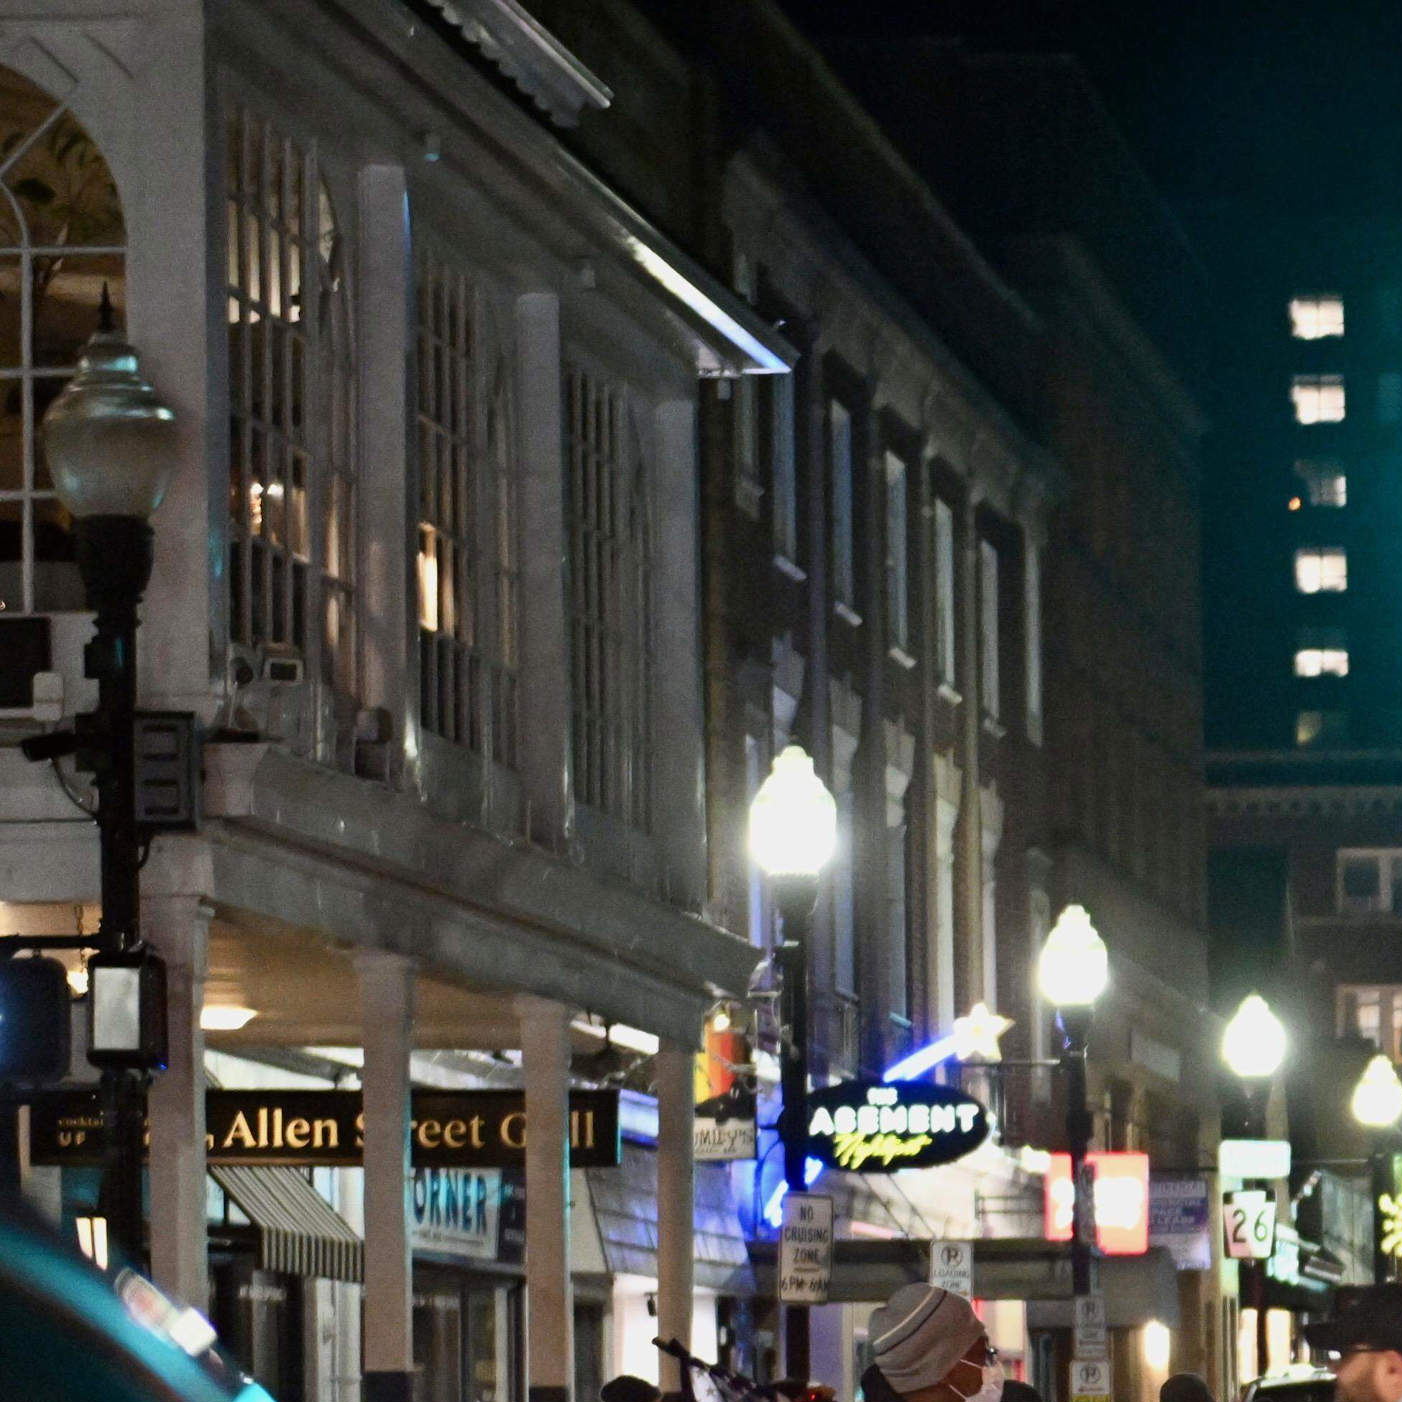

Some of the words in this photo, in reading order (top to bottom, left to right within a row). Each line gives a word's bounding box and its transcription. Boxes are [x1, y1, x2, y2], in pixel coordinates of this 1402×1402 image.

[223, 1107, 338, 1148] Allen
[500, 1109, 594, 1149] Gll
[412, 1167, 487, 1234] ORNER
[800, 1205, 814, 1221] NO
[1232, 1209, 1268, 1243] 26
